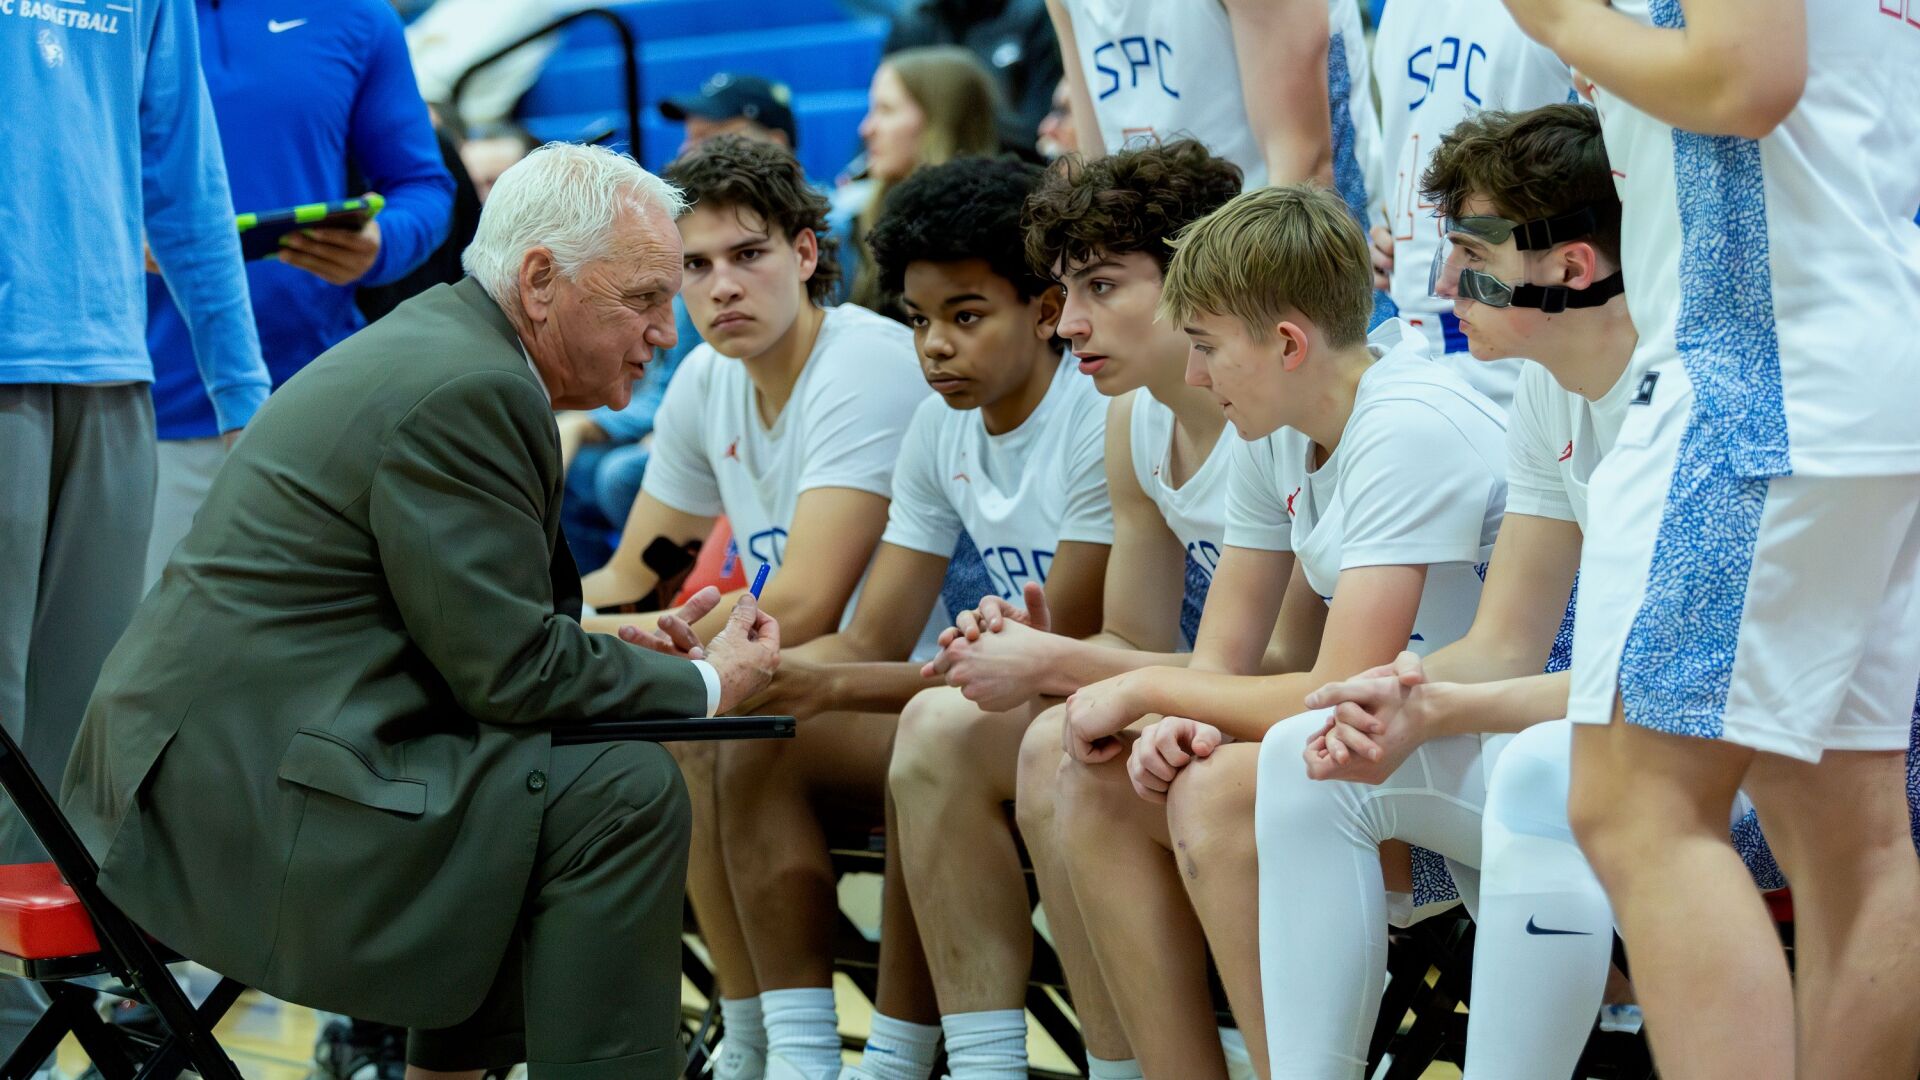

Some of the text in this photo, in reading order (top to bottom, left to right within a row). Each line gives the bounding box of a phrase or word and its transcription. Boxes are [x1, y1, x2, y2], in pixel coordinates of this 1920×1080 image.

[19, 0, 119, 34] BASKETBALL
[1094, 36, 1181, 101] SPC
[1407, 36, 1487, 111] SPC
